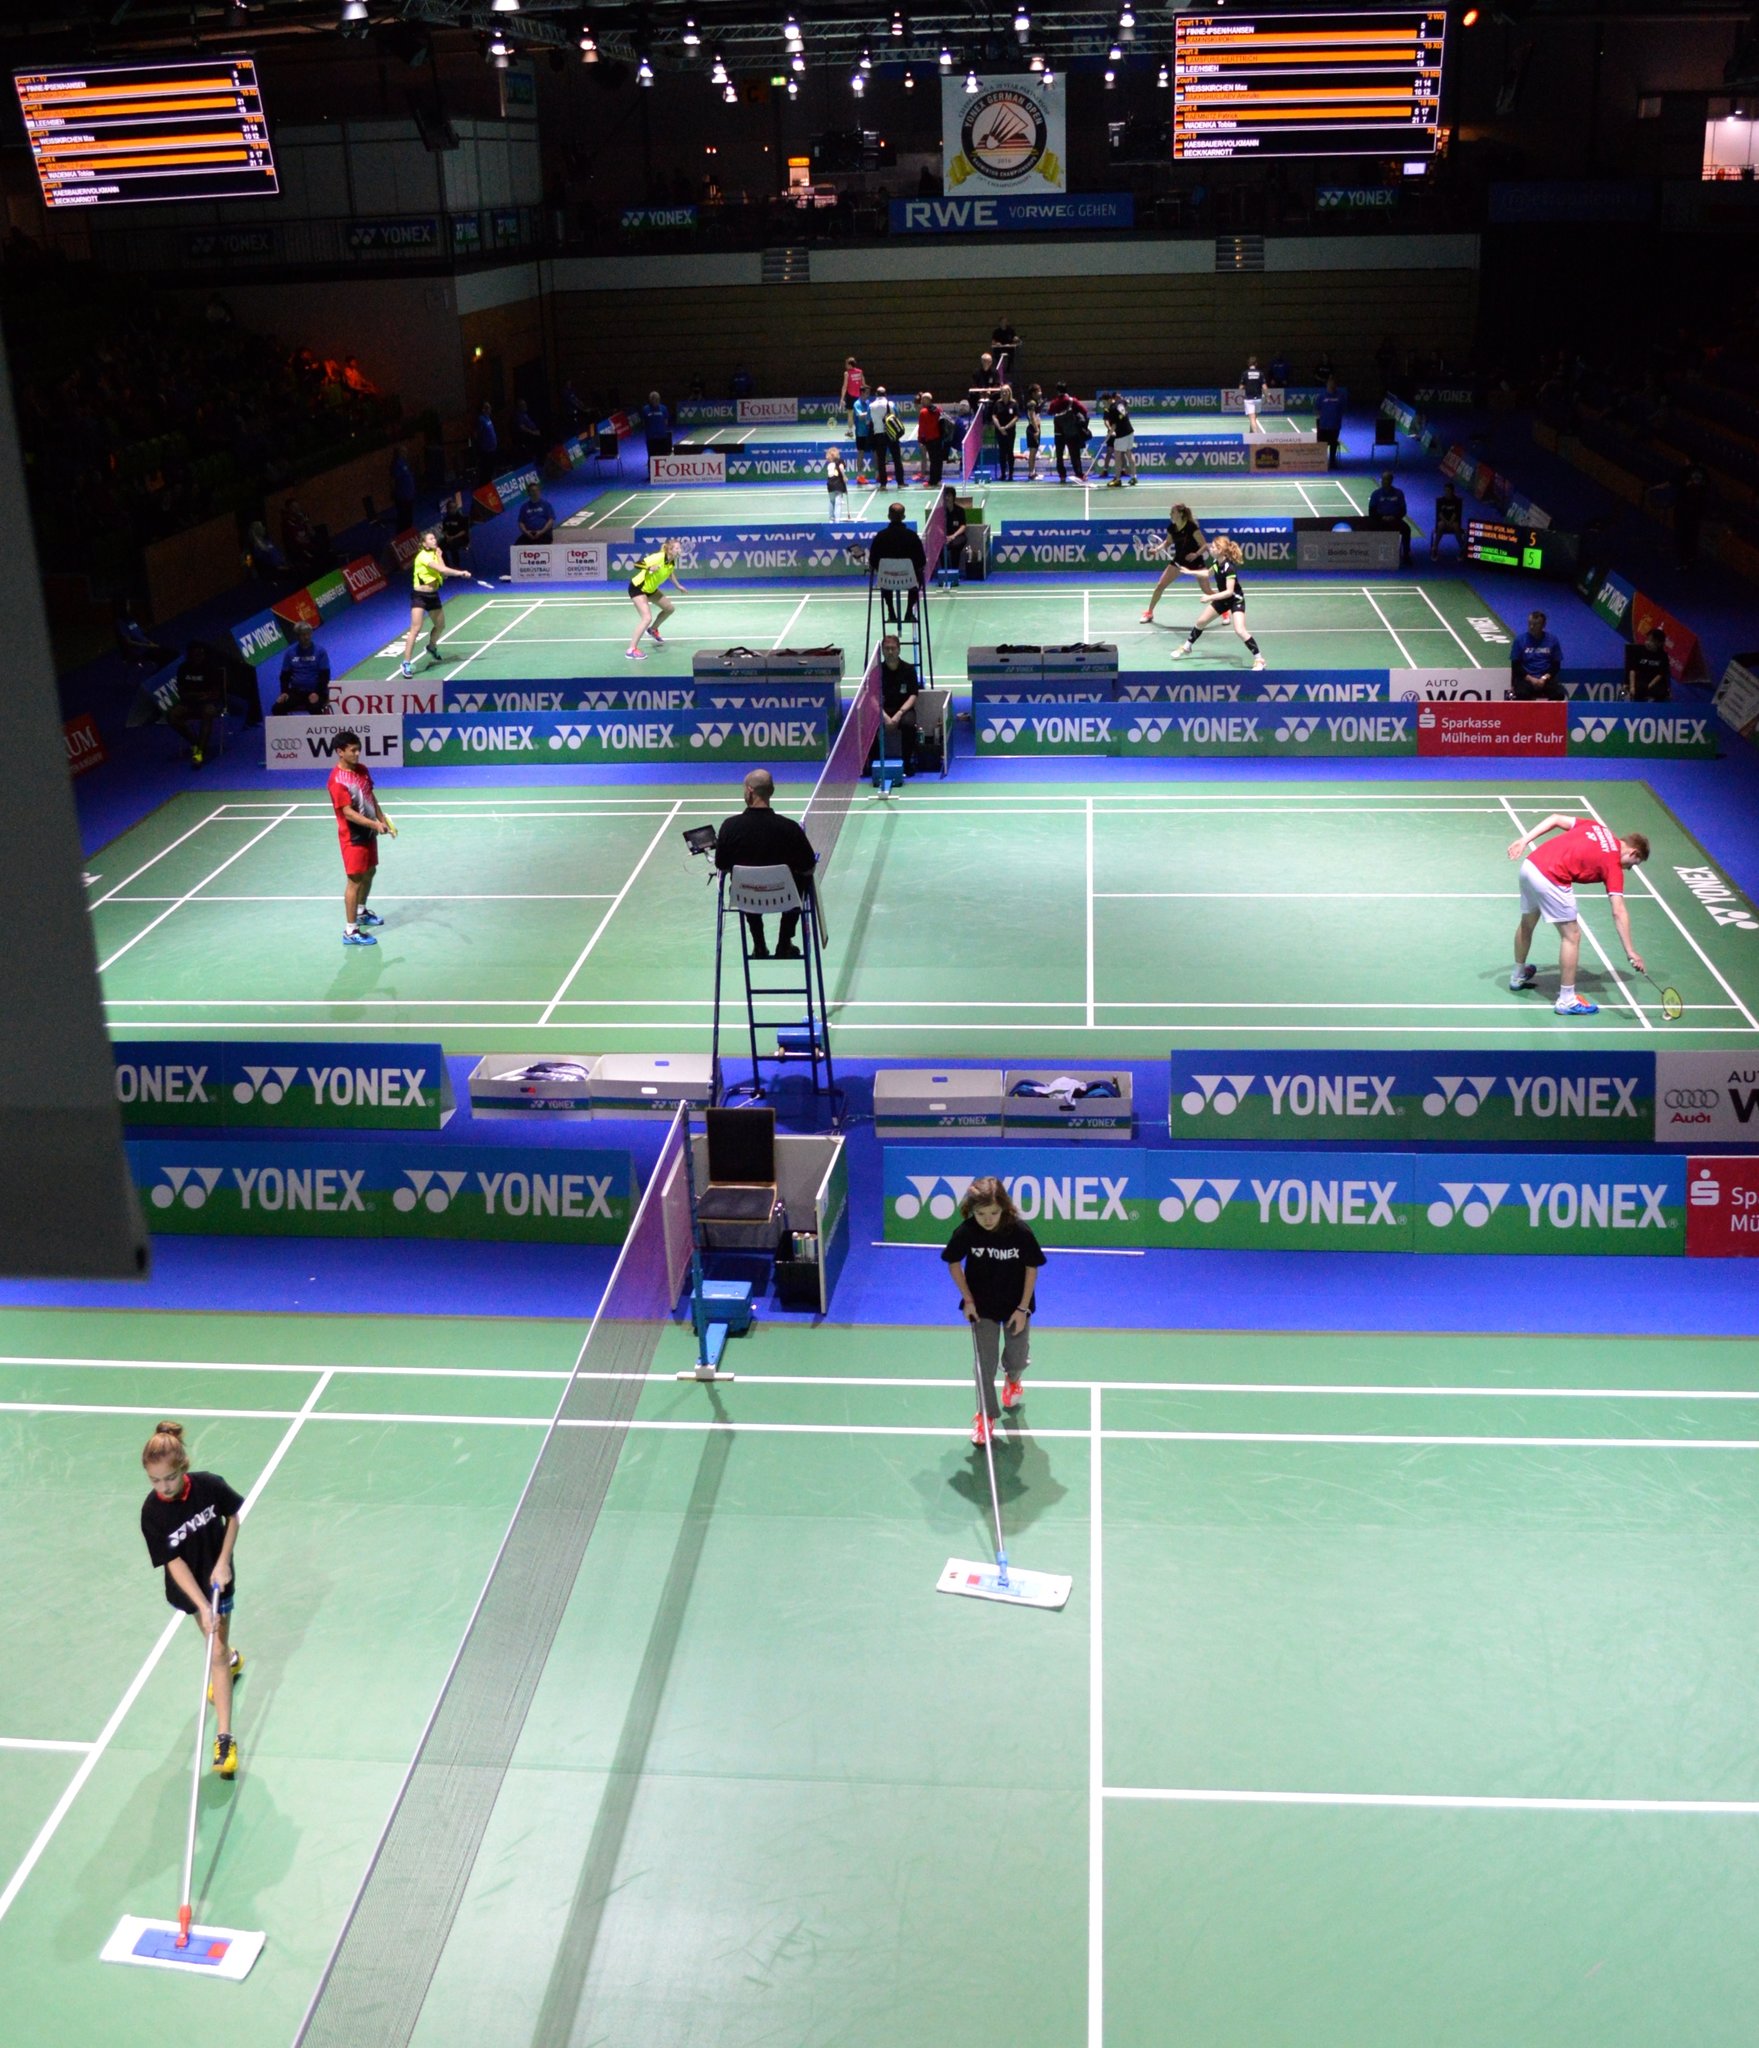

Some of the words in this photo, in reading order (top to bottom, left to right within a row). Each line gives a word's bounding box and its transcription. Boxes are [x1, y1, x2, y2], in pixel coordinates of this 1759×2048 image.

[964, 103, 985, 128] YONEX
[986, 92, 1025, 105] GERMAN
[1026, 102, 1044, 125] OPEN
[1348, 189, 1393, 206] YONEX
[648, 210, 692, 226] YONEX
[906, 200, 998, 228] RWE
[1078, 203, 1116, 217] GEHEN
[380, 224, 432, 244] YONEX
[1183, 396, 1217, 406] YONEX
[1437, 390, 1473, 404] YONEX
[701, 406, 734, 417] YONEX
[739, 400, 796, 417] FORUM
[653, 459, 723, 477] FORUM
[755, 460, 796, 474] YONEX
[1202, 452, 1244, 466] YONEX
[1529, 532, 1536, 547] 5
[571, 550, 588, 558] top
[744, 550, 797, 568] YONEX
[1031, 545, 1087, 562] YONEX
[1133, 544, 1175, 561] YONE
[1528, 551, 1534, 565] 5
[252, 620, 282, 649] YONEX
[493, 692, 564, 712] YONEX
[623, 690, 695, 709] YONEX
[1165, 685, 1240, 702] YONEX
[1304, 684, 1381, 702] YONEX
[306, 725, 370, 735] AUTOHAUS
[1031, 718, 1112, 742] YONEX
[1178, 717, 1260, 742] YONEX
[1325, 717, 1407, 742] YONEX
[1441, 717, 1501, 730] Sparkasse
[1624, 718, 1707, 744] YONEX
[457, 726, 534, 750] YONEX
[597, 723, 674, 748] YONEX
[739, 722, 817, 747] YONEX
[1441, 732, 1492, 744] Mülheim
[1495, 734, 1509, 743] an
[1512, 733, 1531, 743] der
[1535, 732, 1564, 743] Ruhr
[307, 736, 398, 758] WLF
[1673, 866, 1736, 904] YONEX
[116, 1066, 209, 1103] ONEX
[306, 1068, 426, 1106] YONEX
[546, 1100, 576, 1110] YONEX
[1264, 1075, 1396, 1117] YONEX
[1506, 1076, 1638, 1118] YONEX
[958, 1116, 987, 1126] YONEX
[1087, 1118, 1116, 1127] YONEX
[1671, 1113, 1711, 1123] Audi
[233, 1168, 365, 1211] YONEX
[477, 1172, 613, 1218] YONEX
[1252, 1179, 1397, 1225] YONEX
[1520, 1183, 1668, 1228] YONEX
[987, 1247, 1019, 1260] YONEX
